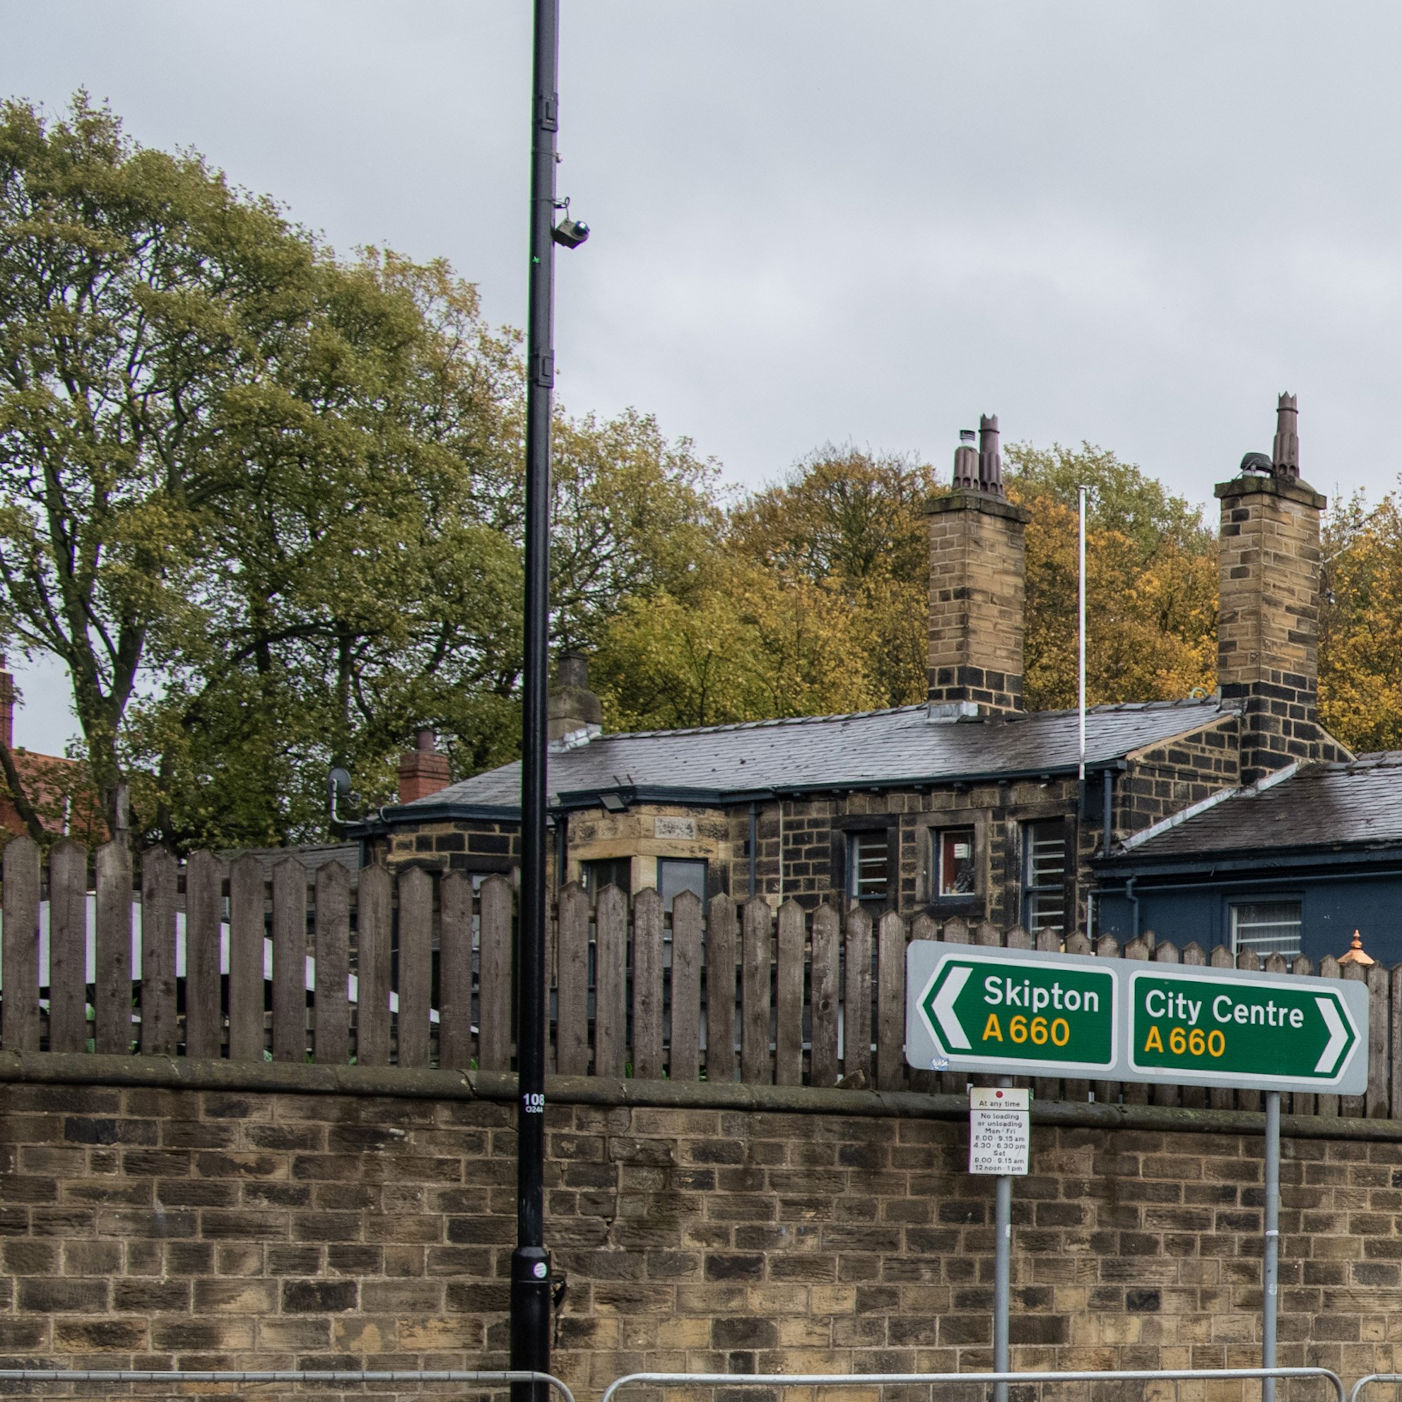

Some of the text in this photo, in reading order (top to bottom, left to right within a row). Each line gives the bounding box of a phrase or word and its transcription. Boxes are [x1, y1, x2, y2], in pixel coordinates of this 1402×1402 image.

[983, 975, 1099, 1013] Skipton
[1145, 989, 1305, 1029] City Centre
[982, 1012, 1071, 1047] A660
[1144, 1025, 1226, 1058] A660
[523, 1093, 545, 1106] 108
